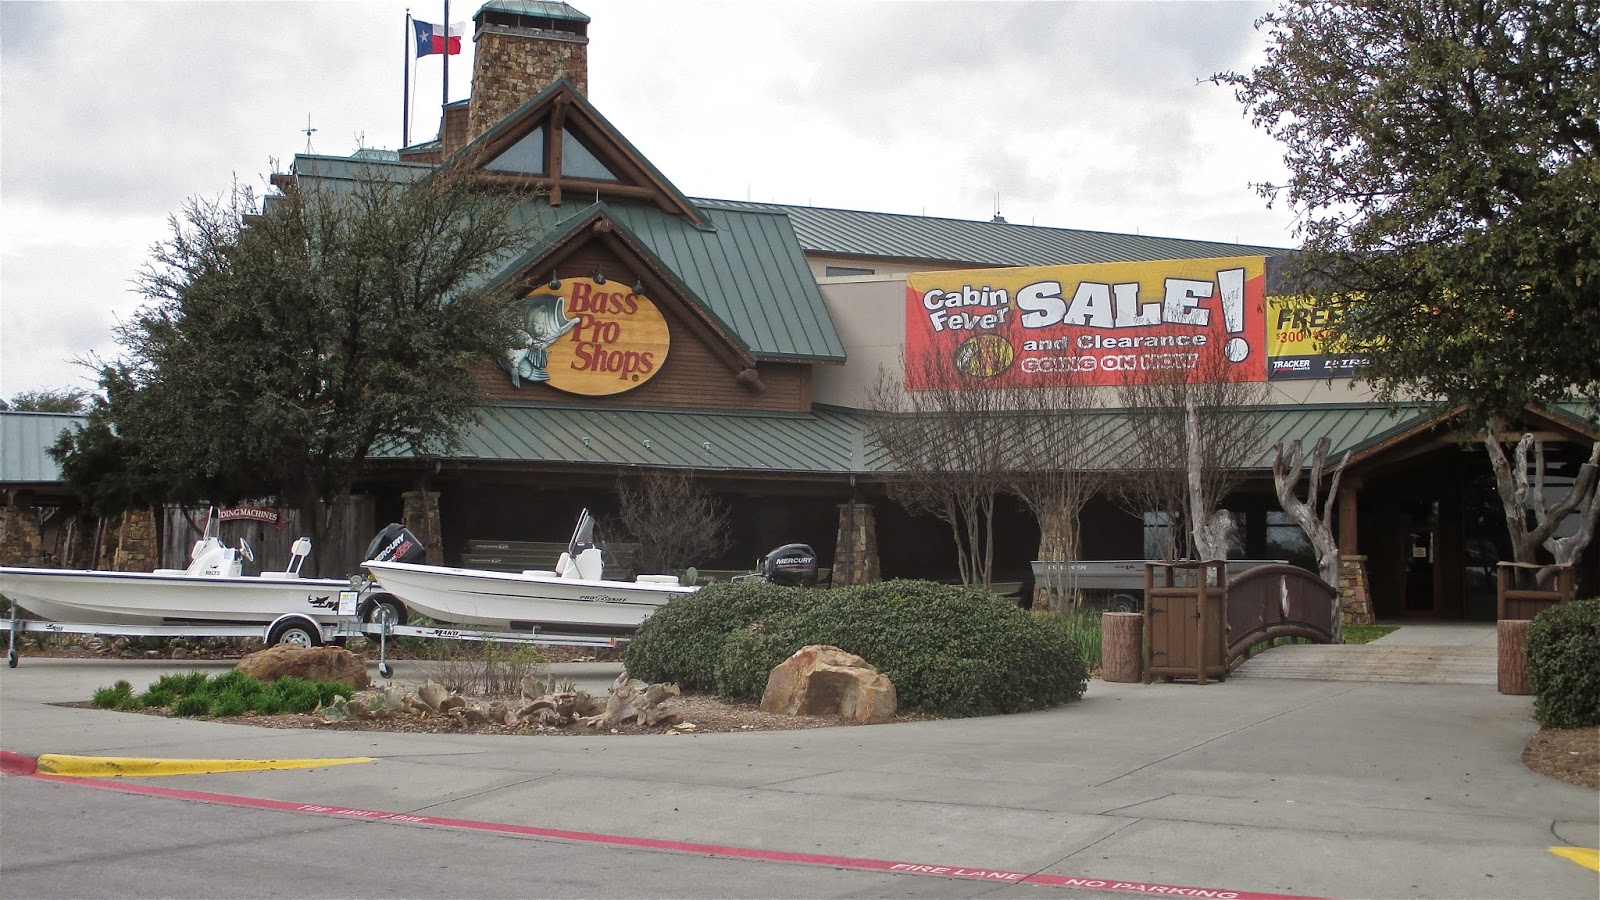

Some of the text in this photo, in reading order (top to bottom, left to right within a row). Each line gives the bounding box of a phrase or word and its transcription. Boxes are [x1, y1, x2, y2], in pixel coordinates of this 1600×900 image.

[567, 282, 638, 315] Bass
[923, 284, 1009, 311] Cabin
[570, 313, 621, 344] Pro
[929, 306, 1009, 332] Fever
[1023, 334, 1207, 351] and Clearance
[1276, 330, 1305, 343] $300
[571, 341, 655, 381] Shops
[1021, 352, 1199, 373] GOING ON NOW
[1273, 360, 1310, 368] TRACKER
[221, 508, 278, 521] DING MACHINES
[776, 557, 813, 565] MERCURY
[890, 863, 1026, 880] FIRE LANE
[1065, 878, 1239, 900] NO PARKING
